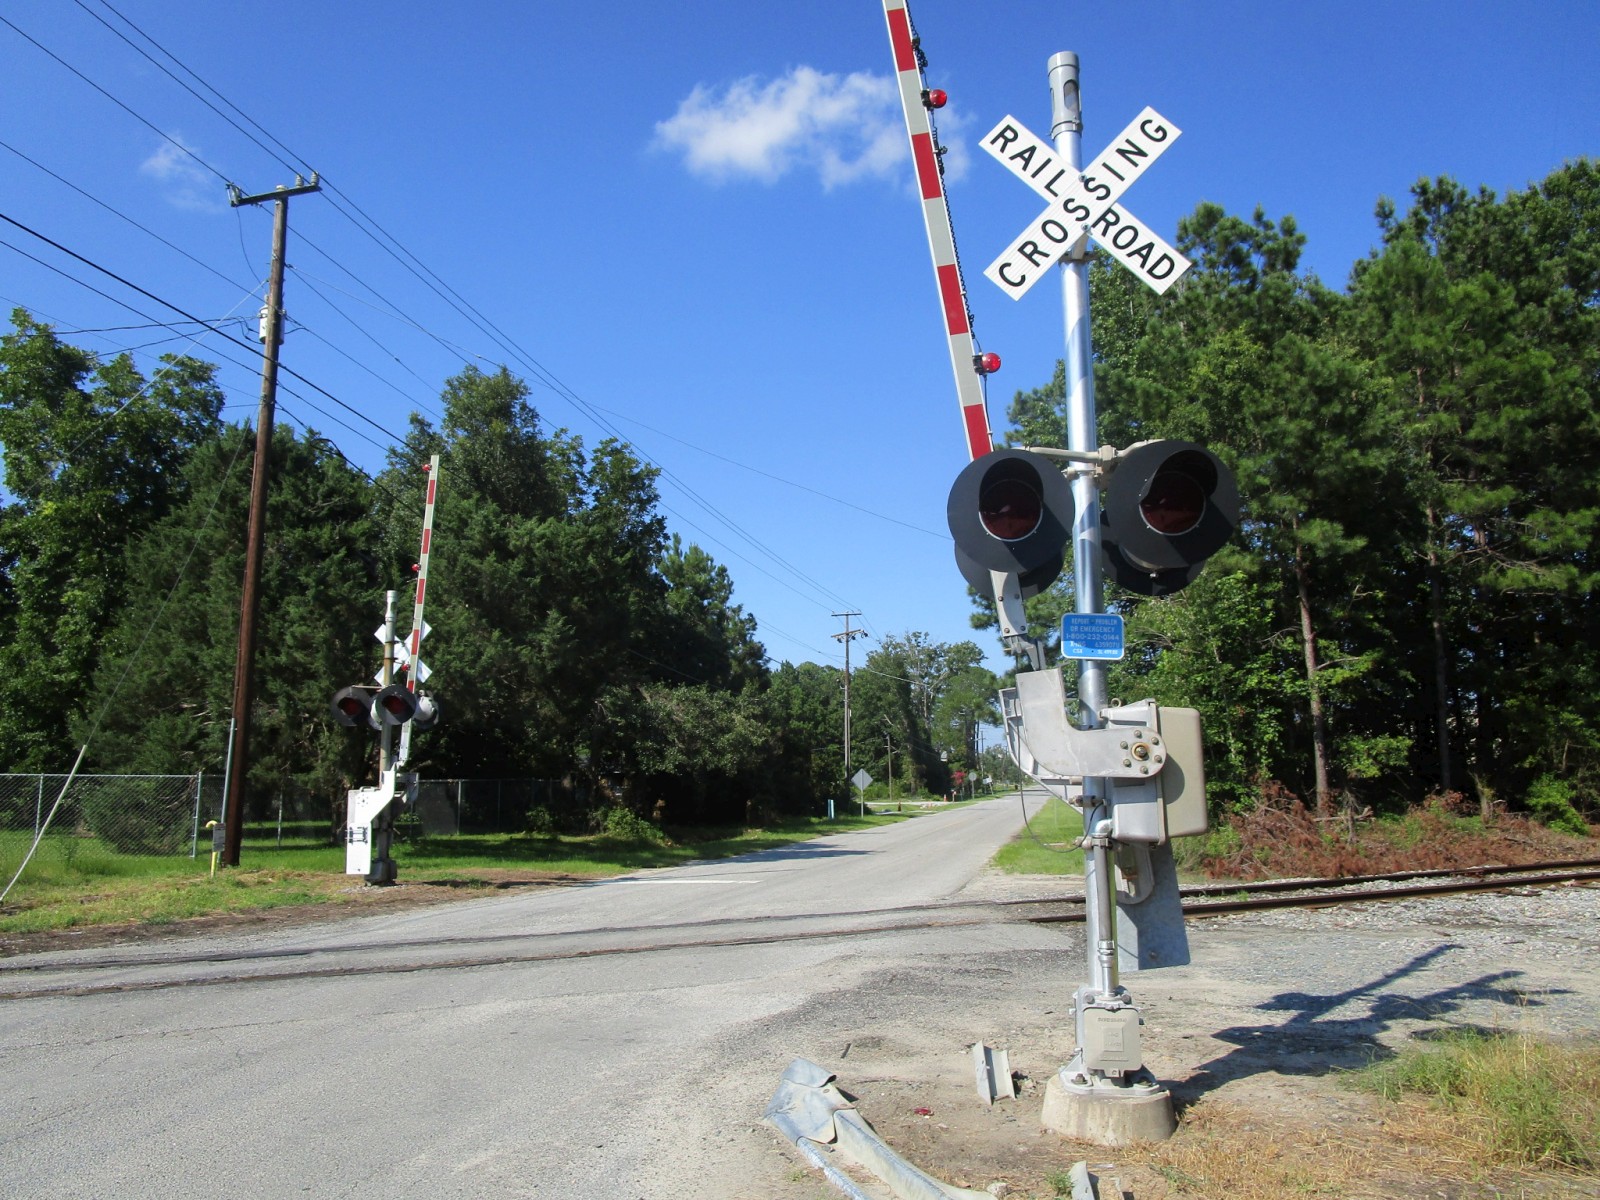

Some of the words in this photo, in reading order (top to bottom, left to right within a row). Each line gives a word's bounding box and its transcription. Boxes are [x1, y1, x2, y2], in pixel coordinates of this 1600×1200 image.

[990, 124, 1066, 198] RAIL
[1091, 207, 1175, 281] ROAD
[998, 119, 1168, 288] CROSSING
